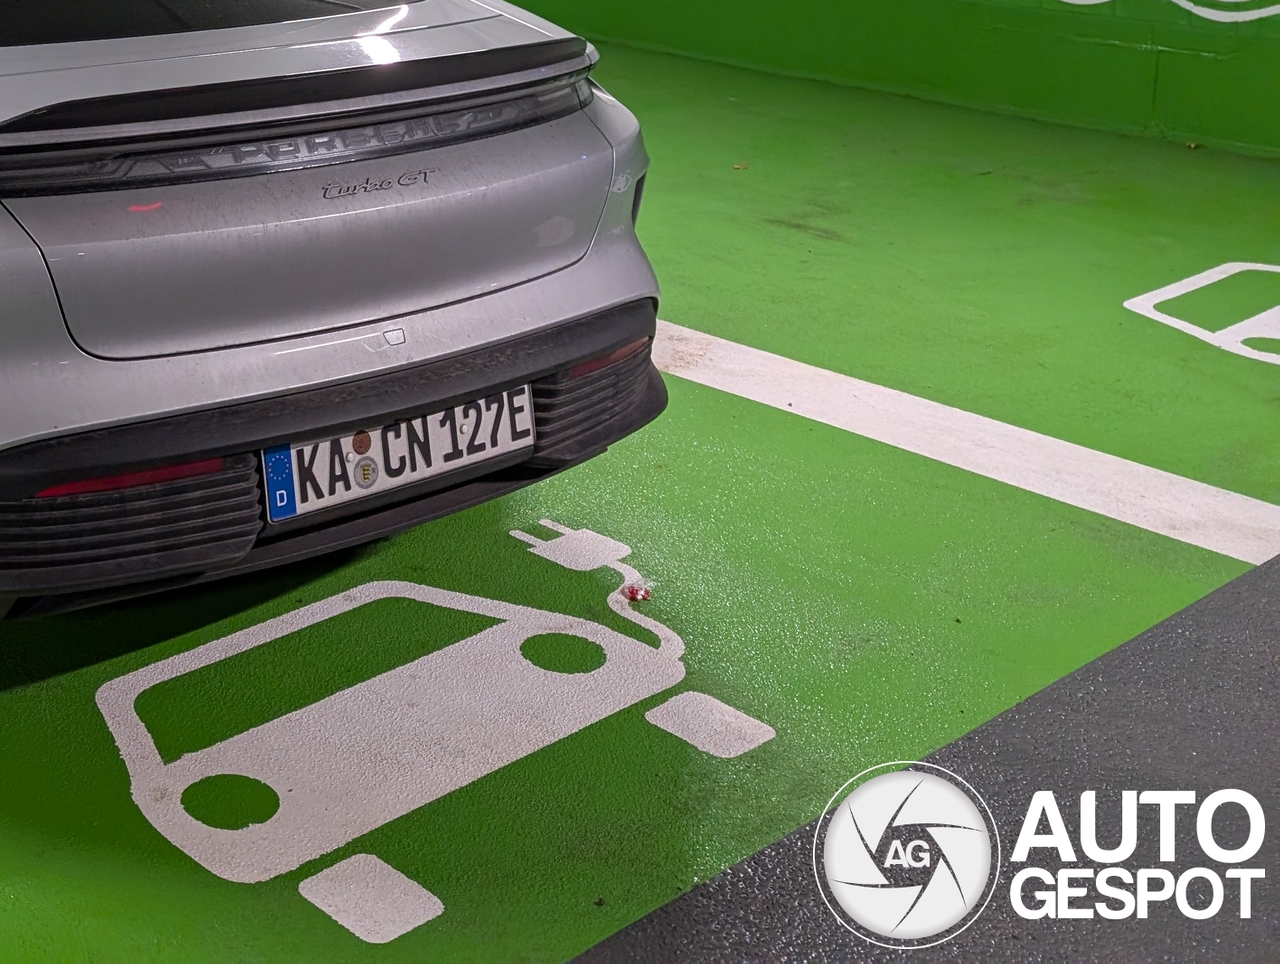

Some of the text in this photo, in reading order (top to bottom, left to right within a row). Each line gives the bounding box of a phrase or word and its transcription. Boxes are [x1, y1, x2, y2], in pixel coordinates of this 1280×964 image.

[322, 168, 440, 200] turbo GT
[296, 438, 352, 504] KA
[381, 414, 433, 479] CN
[439, 387, 531, 463] 127E
[276, 489, 288, 507] D
